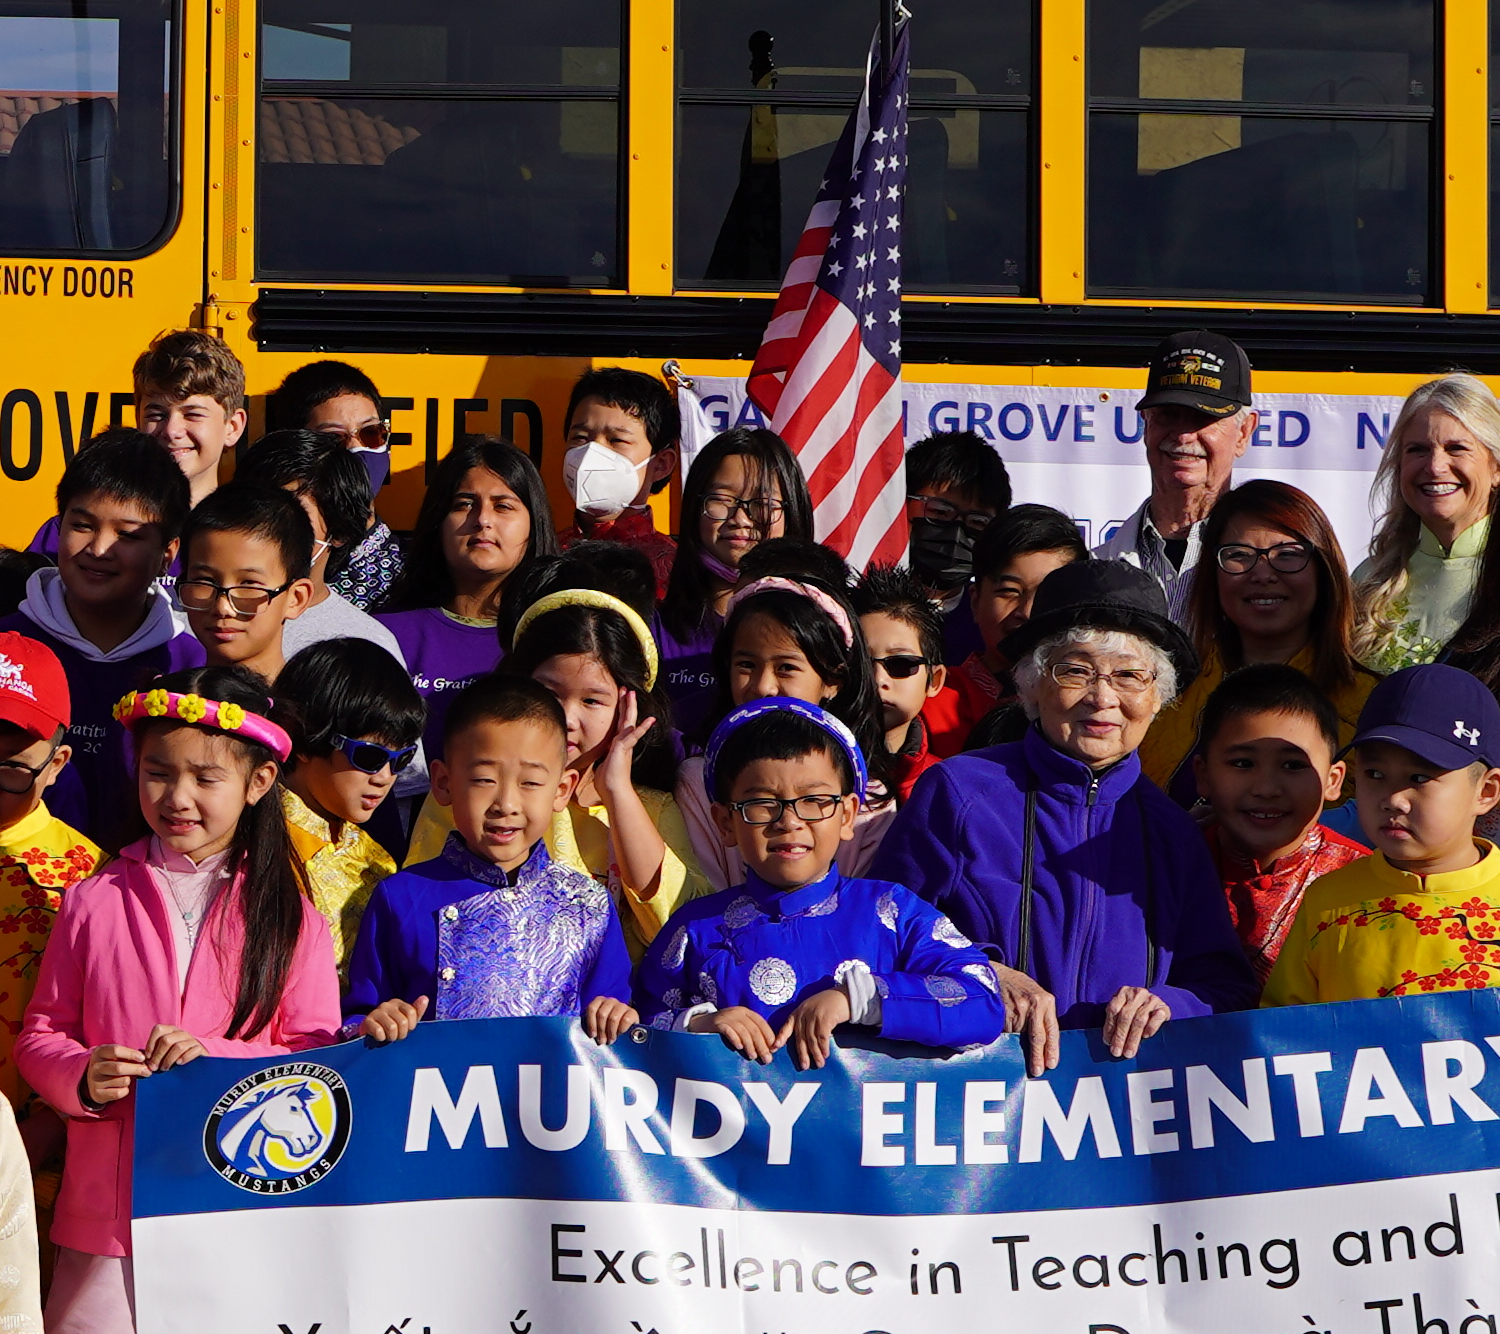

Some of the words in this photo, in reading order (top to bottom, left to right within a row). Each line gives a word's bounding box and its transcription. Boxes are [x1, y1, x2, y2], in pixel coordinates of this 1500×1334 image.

[63, 267, 134, 298] DOOR
[928, 400, 1095, 444] GROVE
[412, 672, 430, 688] he
[669, 669, 695, 683] The
[213, 1075, 257, 1116] MURDY
[264, 1064, 344, 1091] ELEMENTARY
[405, 1066, 821, 1164] MURDY
[222, 1158, 331, 1193] MUSTANGS
[551, 1223, 877, 1295] Excellence
[911, 1248, 961, 1295] in
[992, 1224, 1300, 1291] Teaching
[1333, 1193, 1464, 1266] and
